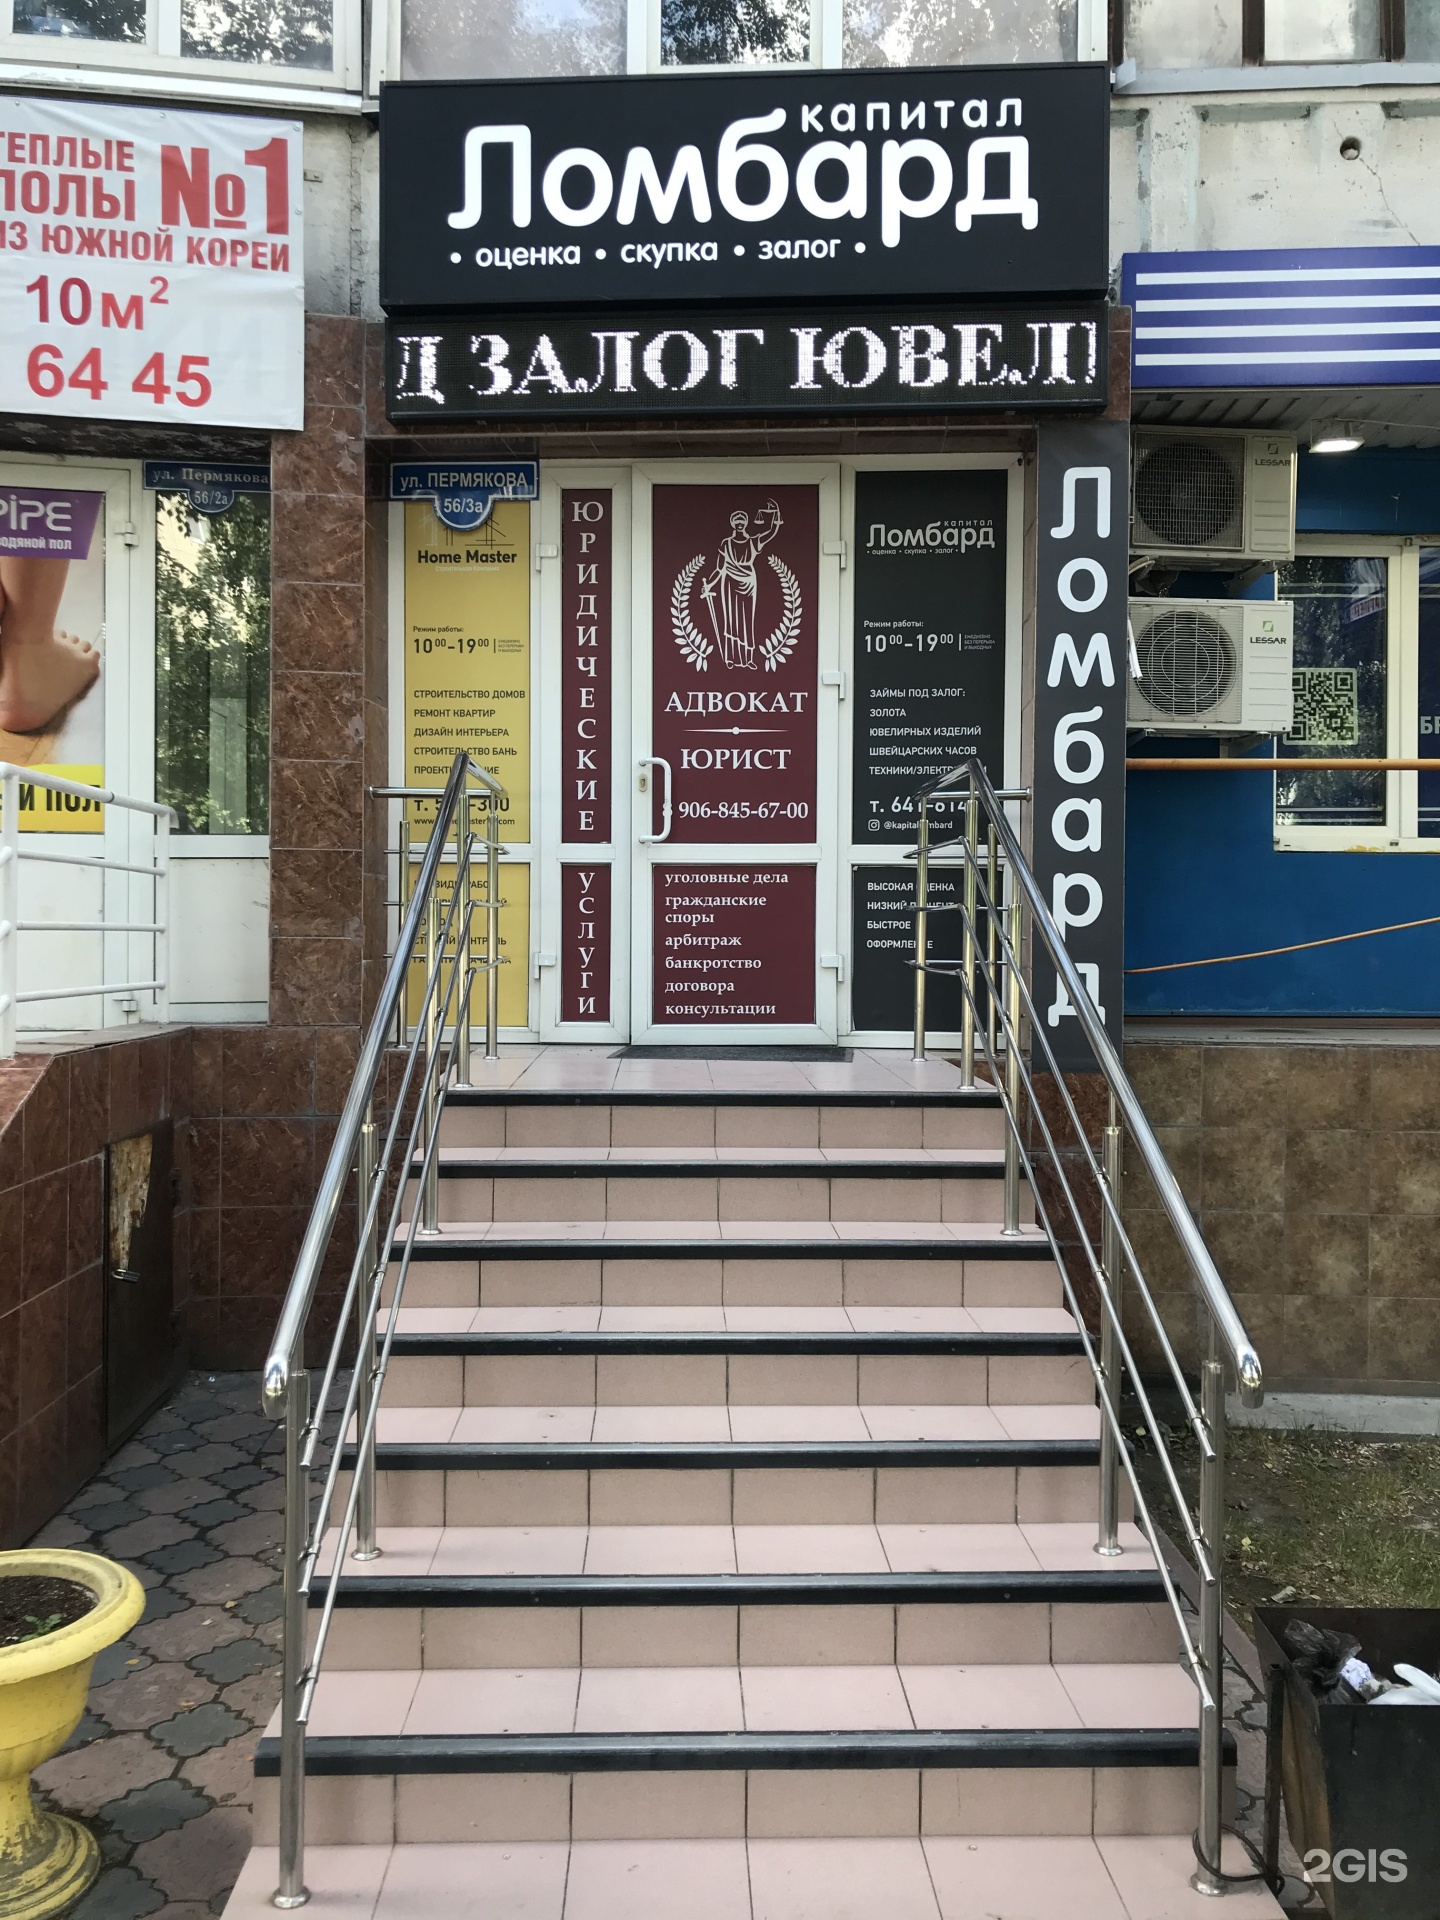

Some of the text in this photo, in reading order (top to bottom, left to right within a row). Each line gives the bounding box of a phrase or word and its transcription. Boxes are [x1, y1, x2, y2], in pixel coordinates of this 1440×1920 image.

[801, 97, 1022, 133] капитал
[447, 108, 1039, 247] Ломбард
[42, 223, 173, 263] ЮЖНОЙ
[187, 236, 290, 272] КОРЕИ
[475, 238, 841, 270] оценка скупка залог
[470, 329, 764, 396] ЗАЛОГ
[27, 344, 212, 408] 64 45
[153, 468, 269, 484] ул. Пермякова
[400, 472, 528, 491] ул. ПЕРМЯКОВА
[866, 521, 996, 554] Ломбард
[418, 550, 517, 564] Home Master
[871, 548, 897, 556] оценка
[438, 626, 464, 634] работы:
[863, 620, 924, 629] Режим работы:
[1250, 636, 1287, 645] LESSAR
[571, 501, 604, 831] ЮРИДИЧЕСКИЕ
[414, 690, 526, 700] СТРОИТЕЛЬСТВО ДОМОВ
[870, 688, 966, 699] ЗАЙМЫ ПОД ЗАЛОГ:
[664, 691, 809, 717] АДВОКАТ
[414, 709, 496, 718] РЕМОНТ КВАРТИР
[869, 708, 907, 717] ЗОЛОТА
[414, 727, 510, 737] ДИЗАЙН ИНТЕРЬЕРА
[869, 725, 982, 737] ЮВЕЛИРНЫХ ИЗДЕЛИЙ
[493, 747, 518, 755] БАНЬ
[869, 746, 977, 756] ШВЕЙЦАРСКИХ ЧАСОВ
[1047, 466, 1116, 1028] Ломбард
[680, 748, 792, 770] ЮРИСТ
[678, 801, 809, 819] 906-845-67-00
[664, 873, 789, 886] уголовные дела
[867, 882, 914, 891] ВЫСОКАЯ
[664, 895, 767, 909] гражданские
[867, 900, 908, 910] НИЗКИЙ
[664, 914, 715, 927] споры
[867, 921, 911, 929] БЫСТРОЕ
[577, 872, 596, 1015] УСЛУГИ
[664, 932, 742, 949] арбитраж
[664, 956, 762, 972] банкротство
[664, 980, 735, 995] договора
[664, 1003, 776, 1018] консультации
